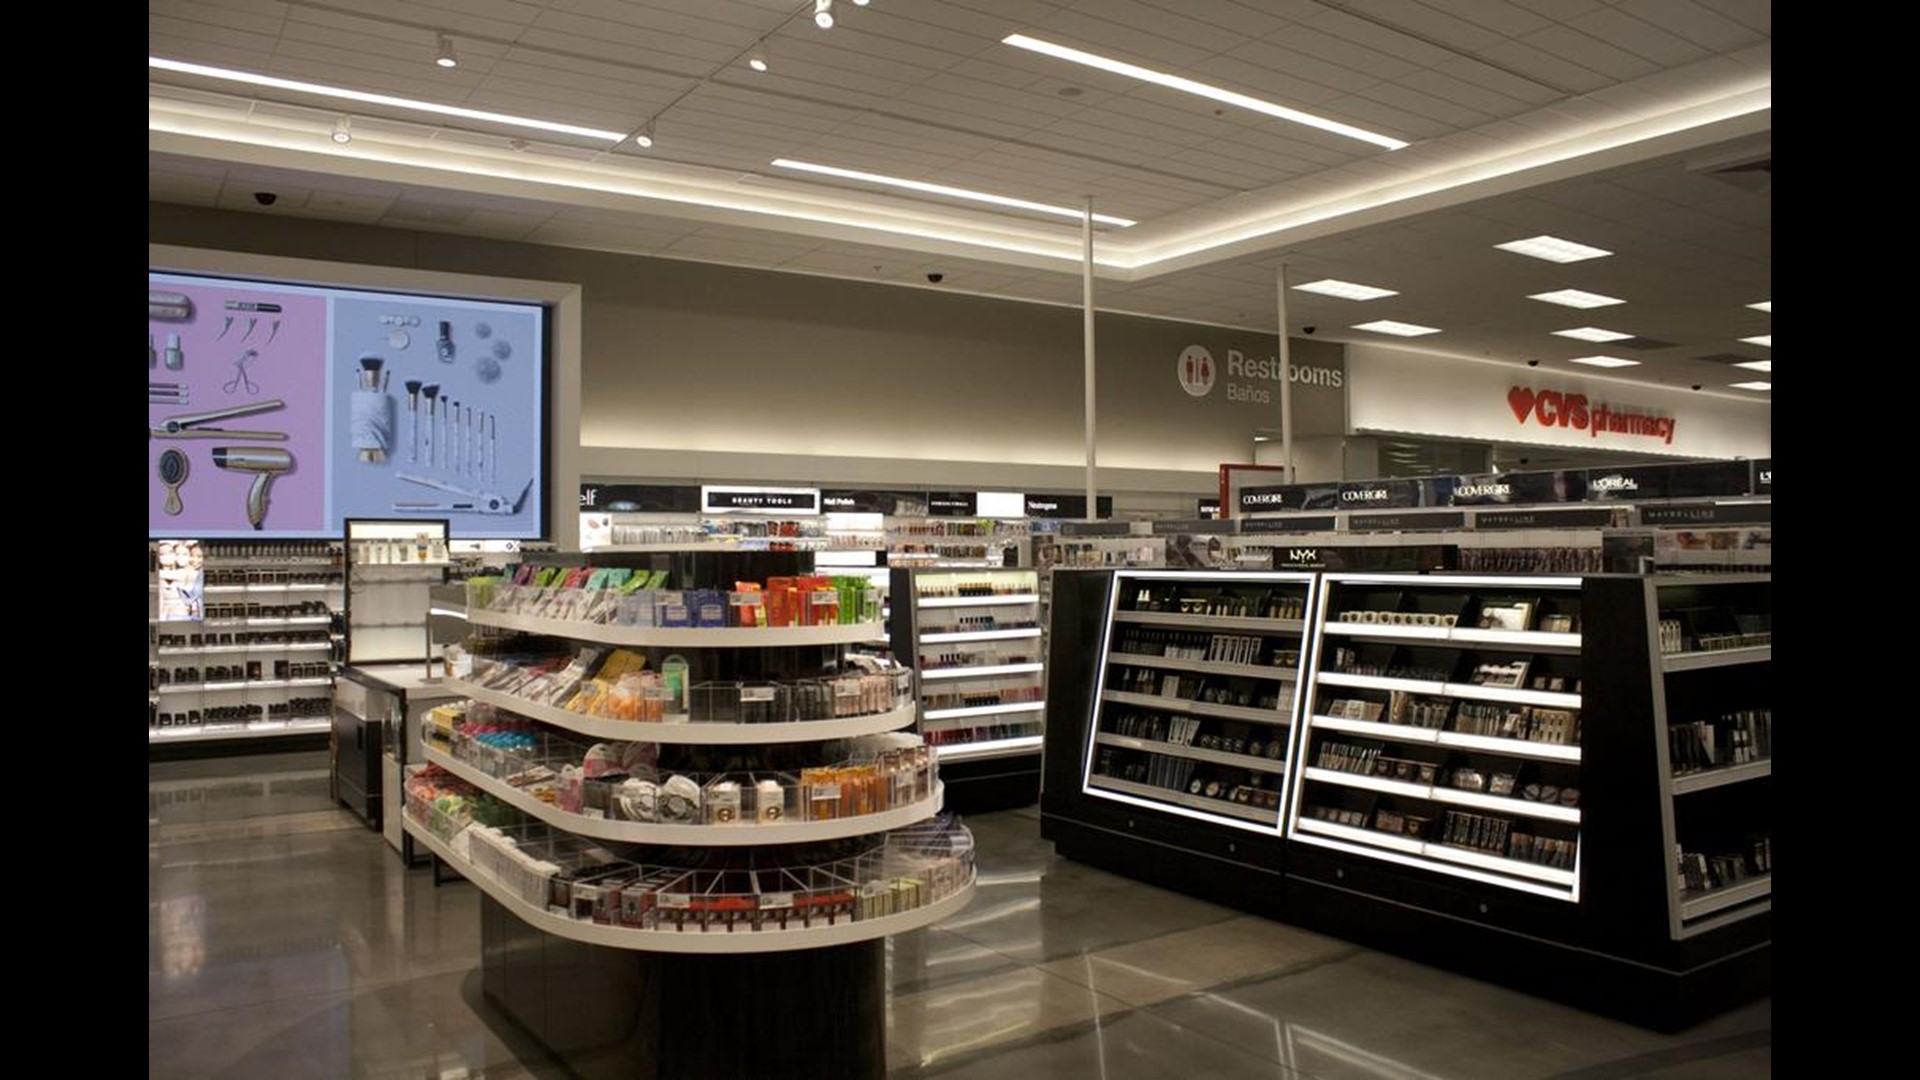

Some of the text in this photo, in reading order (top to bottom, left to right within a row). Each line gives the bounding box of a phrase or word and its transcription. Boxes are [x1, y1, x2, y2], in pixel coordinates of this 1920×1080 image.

[1227, 349, 1342, 388] Restooms
[1227, 383, 1270, 404] Baños
[1535, 389, 1676, 445] CVS pharmacy
[1342, 489, 1389, 502] COVERGIRL
[1457, 484, 1510, 497] COVERGIRL
[1242, 494, 1283, 505] COVERGIRL
[1290, 549, 1316, 563] NYX
